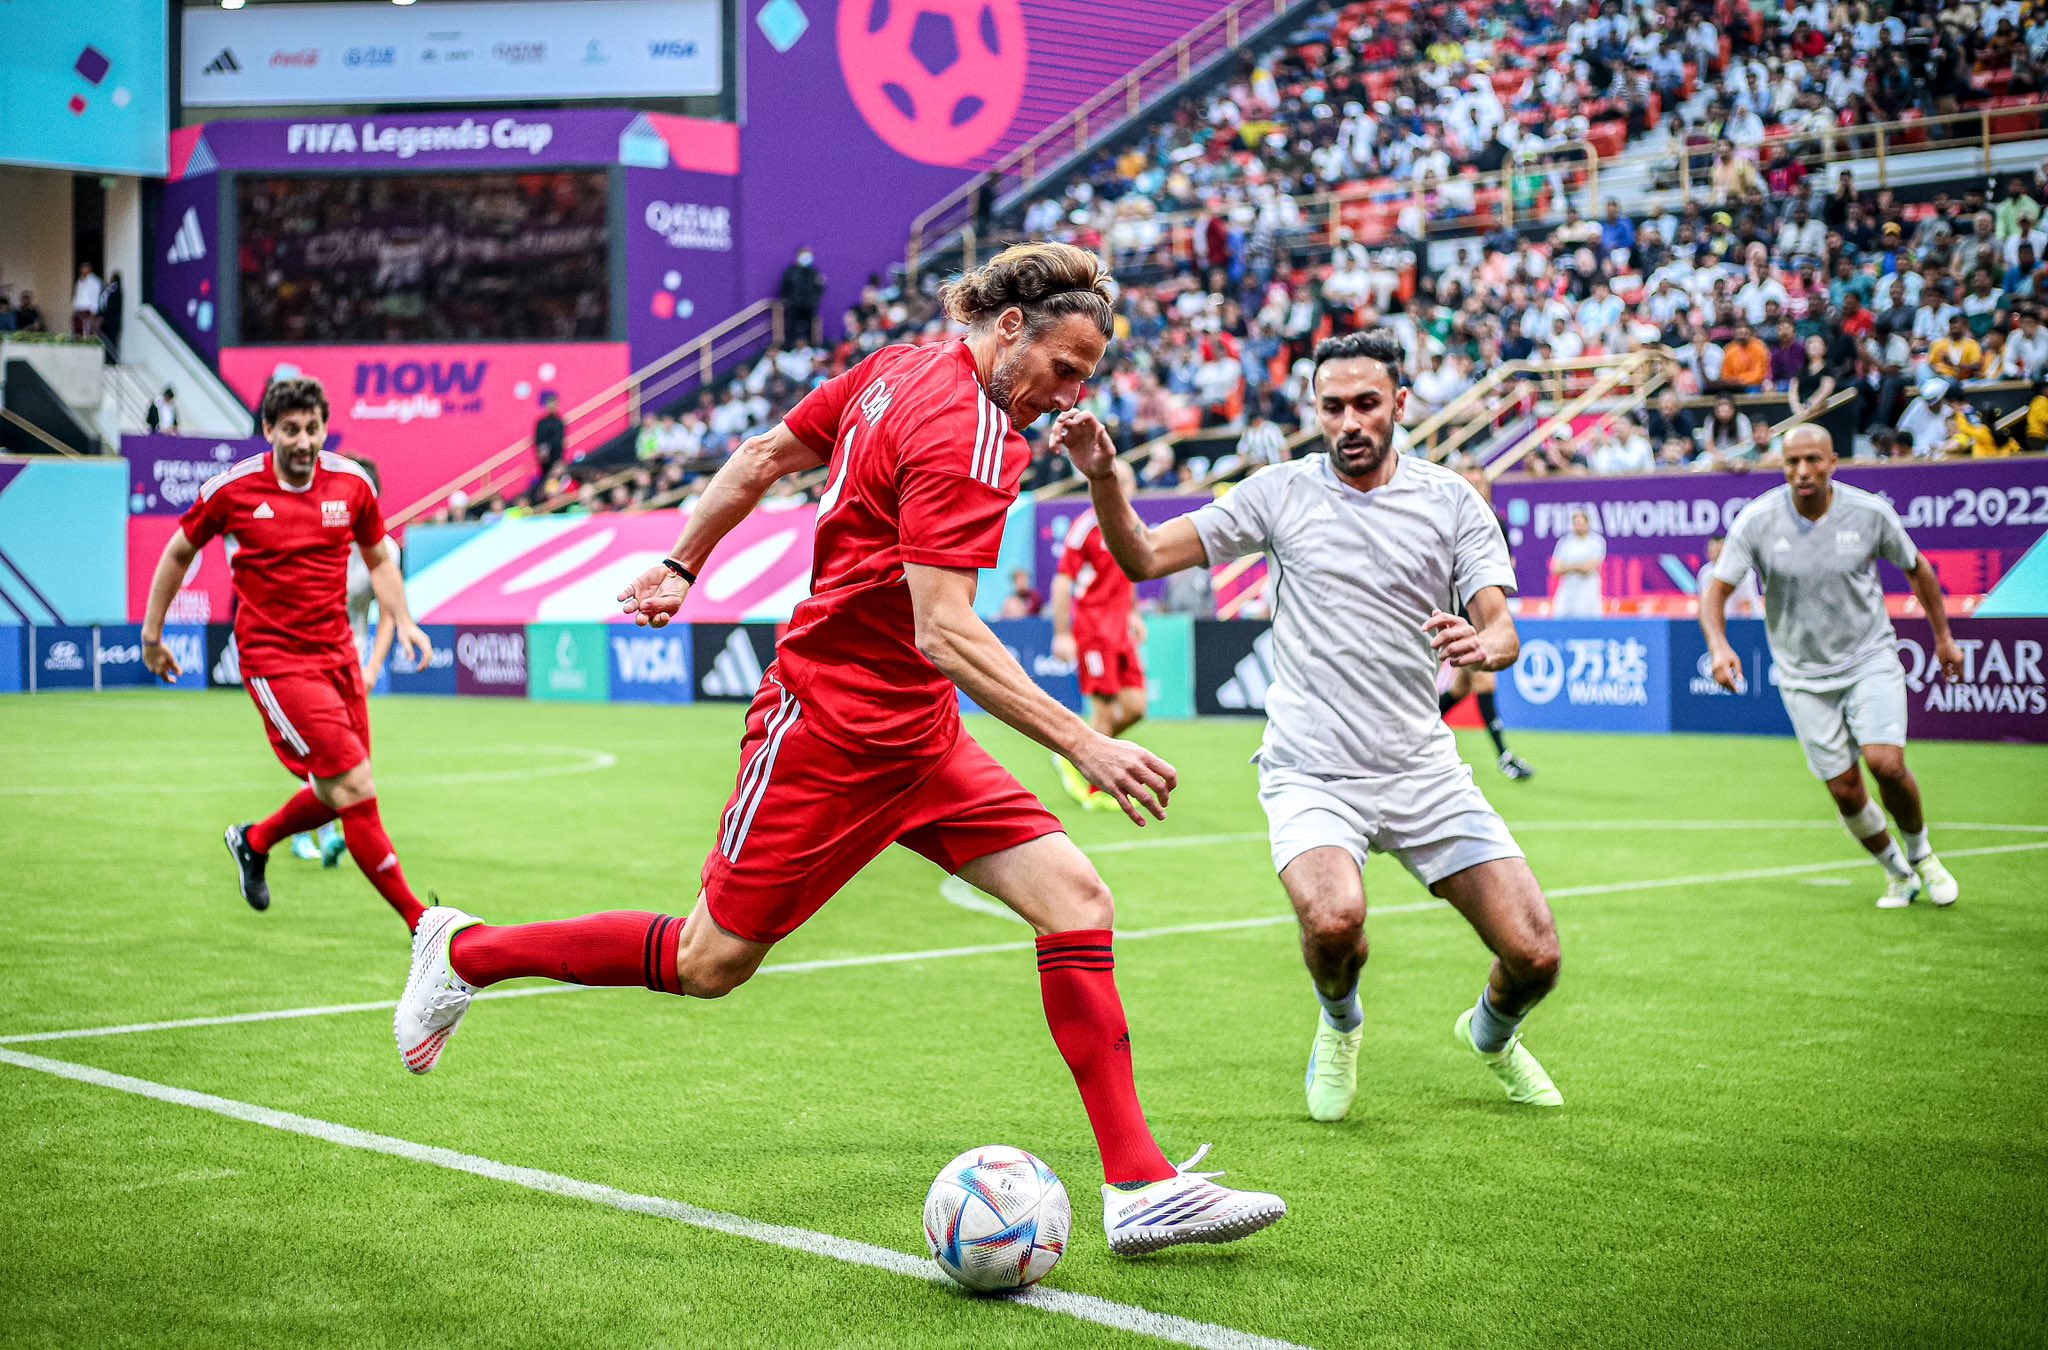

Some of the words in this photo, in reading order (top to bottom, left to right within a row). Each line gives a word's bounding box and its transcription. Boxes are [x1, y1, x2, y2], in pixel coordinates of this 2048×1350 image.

[287, 122, 358, 154] FIFA
[361, 117, 490, 159] Legends
[491, 117, 554, 155] Cup
[356, 360, 487, 395] now
[1602, 499, 1720, 538] WORLD
[457, 633, 525, 672] QATAR
[613, 636, 688, 683] VISA
[1567, 681, 1648, 705] WANDA
[1925, 682, 2047, 715] AIRWAYS
[1118, 1197, 1150, 1218] PREDATOR
